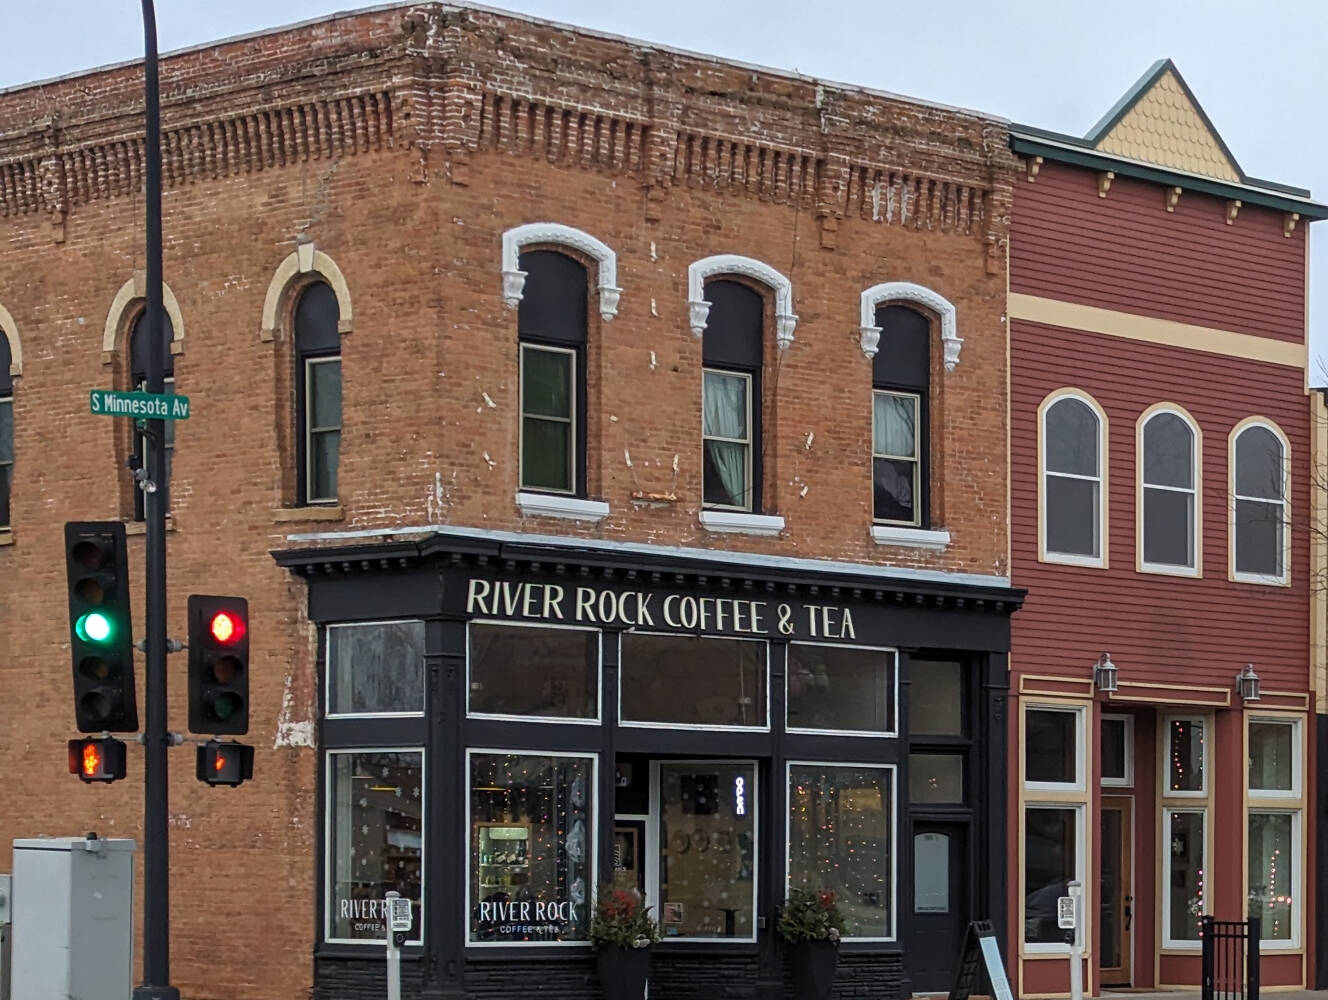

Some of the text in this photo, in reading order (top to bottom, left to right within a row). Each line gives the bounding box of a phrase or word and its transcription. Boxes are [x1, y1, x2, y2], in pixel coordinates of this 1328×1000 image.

[92, 393, 188, 417] S Minnesota Av
[466, 578, 856, 639] RIVER ROCK COFFEE & TEA
[340, 899, 378, 919] RIVER
[480, 901, 578, 921] RIVER ROCK
[500, 925, 533, 934] COFFEE
